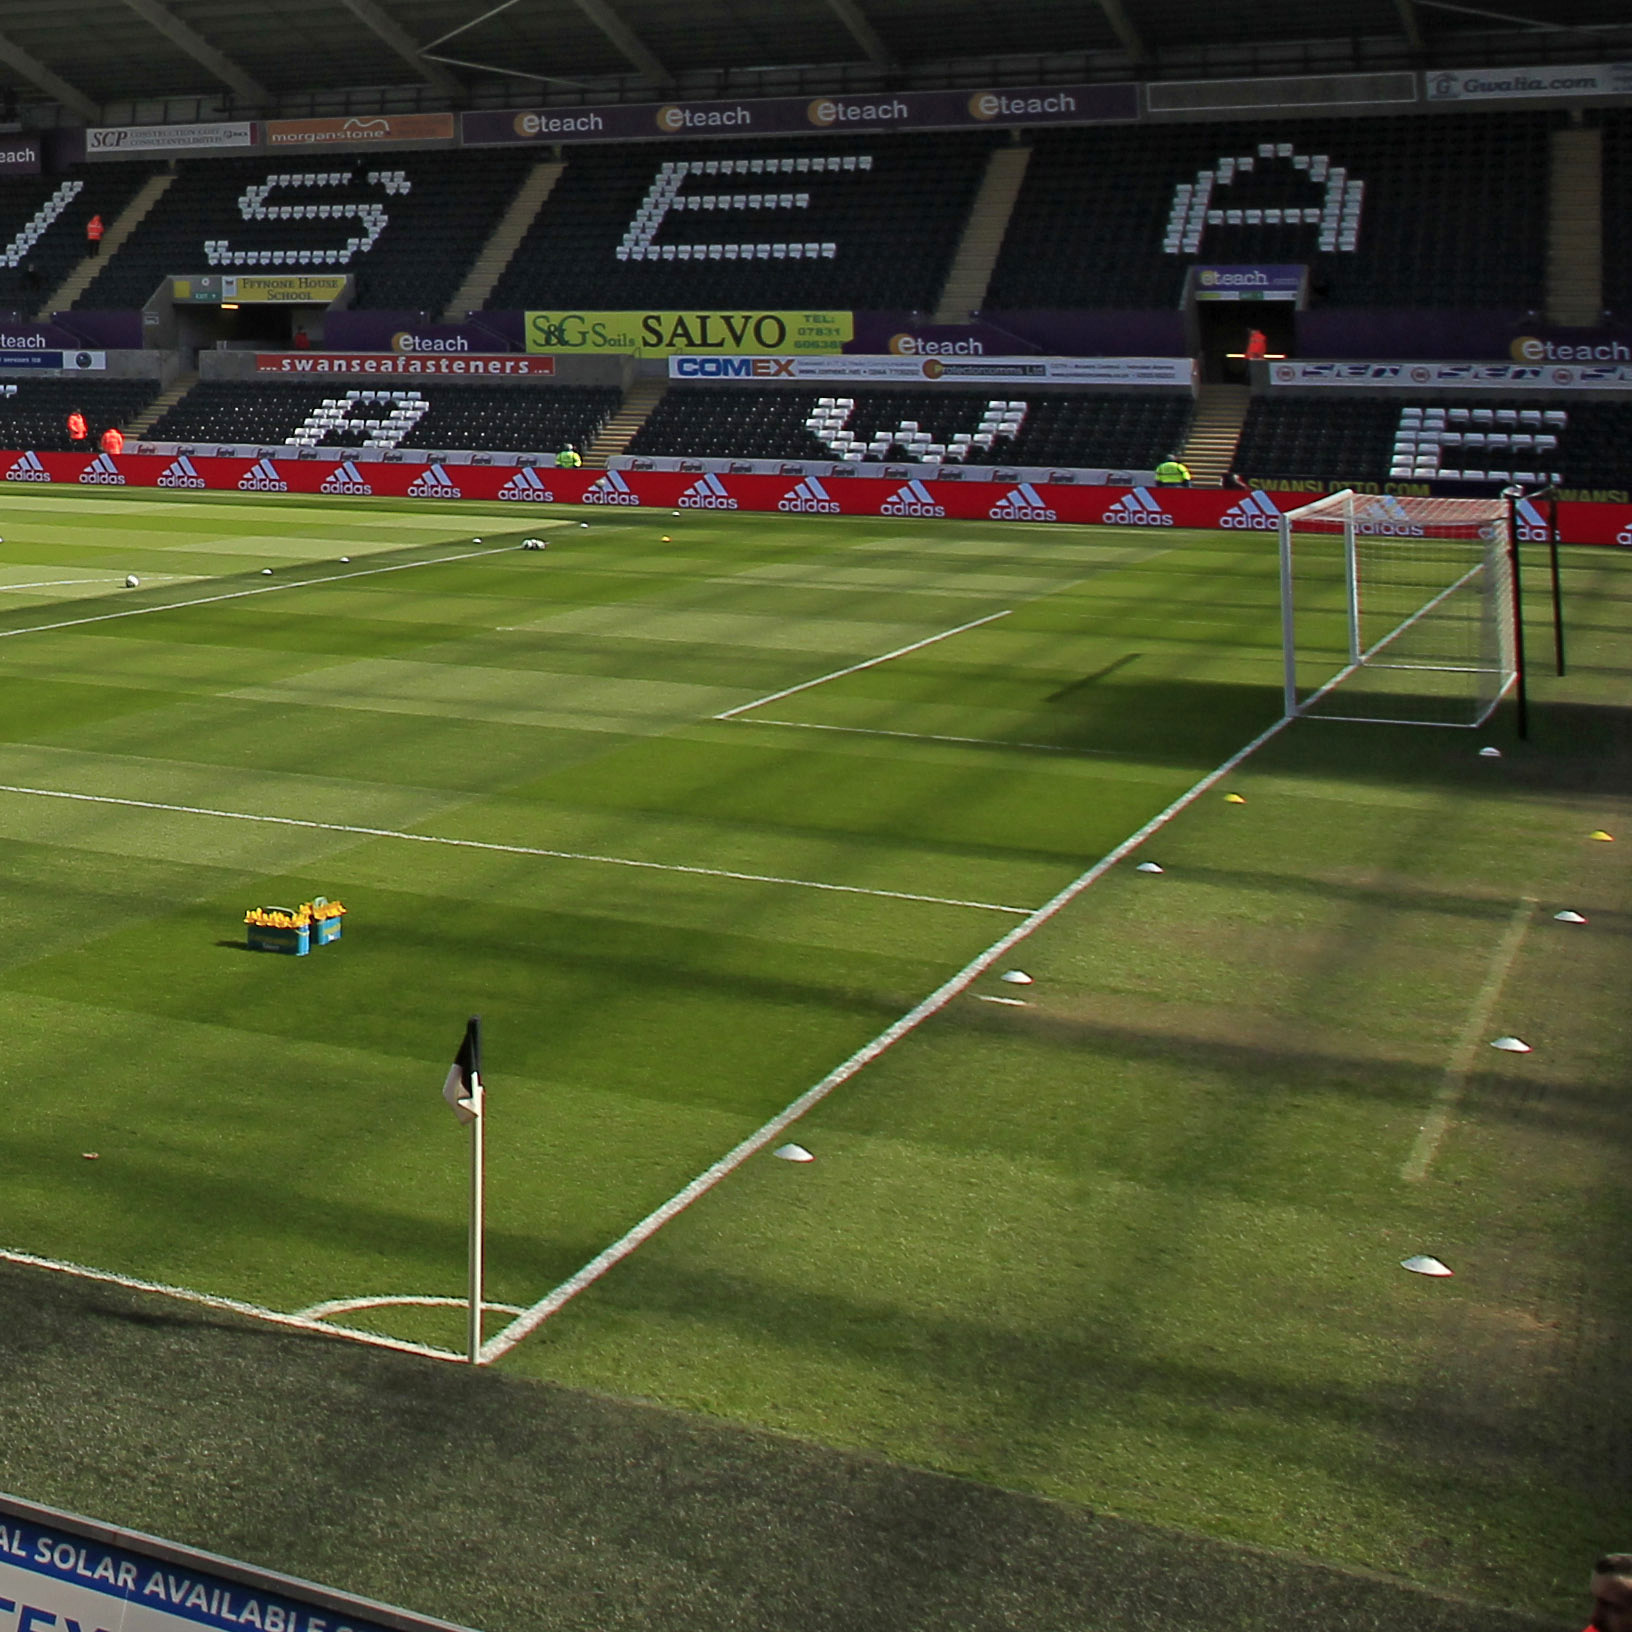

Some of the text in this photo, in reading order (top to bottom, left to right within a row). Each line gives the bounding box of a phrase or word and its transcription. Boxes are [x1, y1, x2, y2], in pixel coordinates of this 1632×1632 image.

[817, 99, 908, 121] eteach
[979, 92, 1076, 115] eteach
[522, 112, 603, 133] eteach
[665, 106, 751, 128] eteach
[91, 131, 128, 149] SCP
[271, 128, 385, 145] morganstone
[531, 314, 787, 349] S&G Soils SALVO
[398, 331, 469, 352] eteach
[898, 335, 984, 356] eteach
[676, 358, 797, 377] COMEX
[5, 469, 51, 483] adidas
[157, 475, 206, 489] adidas
[320, 479, 373, 496] adidas
[498, 486, 554, 503] adidas
[678, 494, 738, 510] adidas
[880, 501, 946, 519] adidas
[988, 504, 1057, 522] adidas
[1102, 509, 1174, 527] adidas
[34, 1536, 140, 1592] SOLAR
